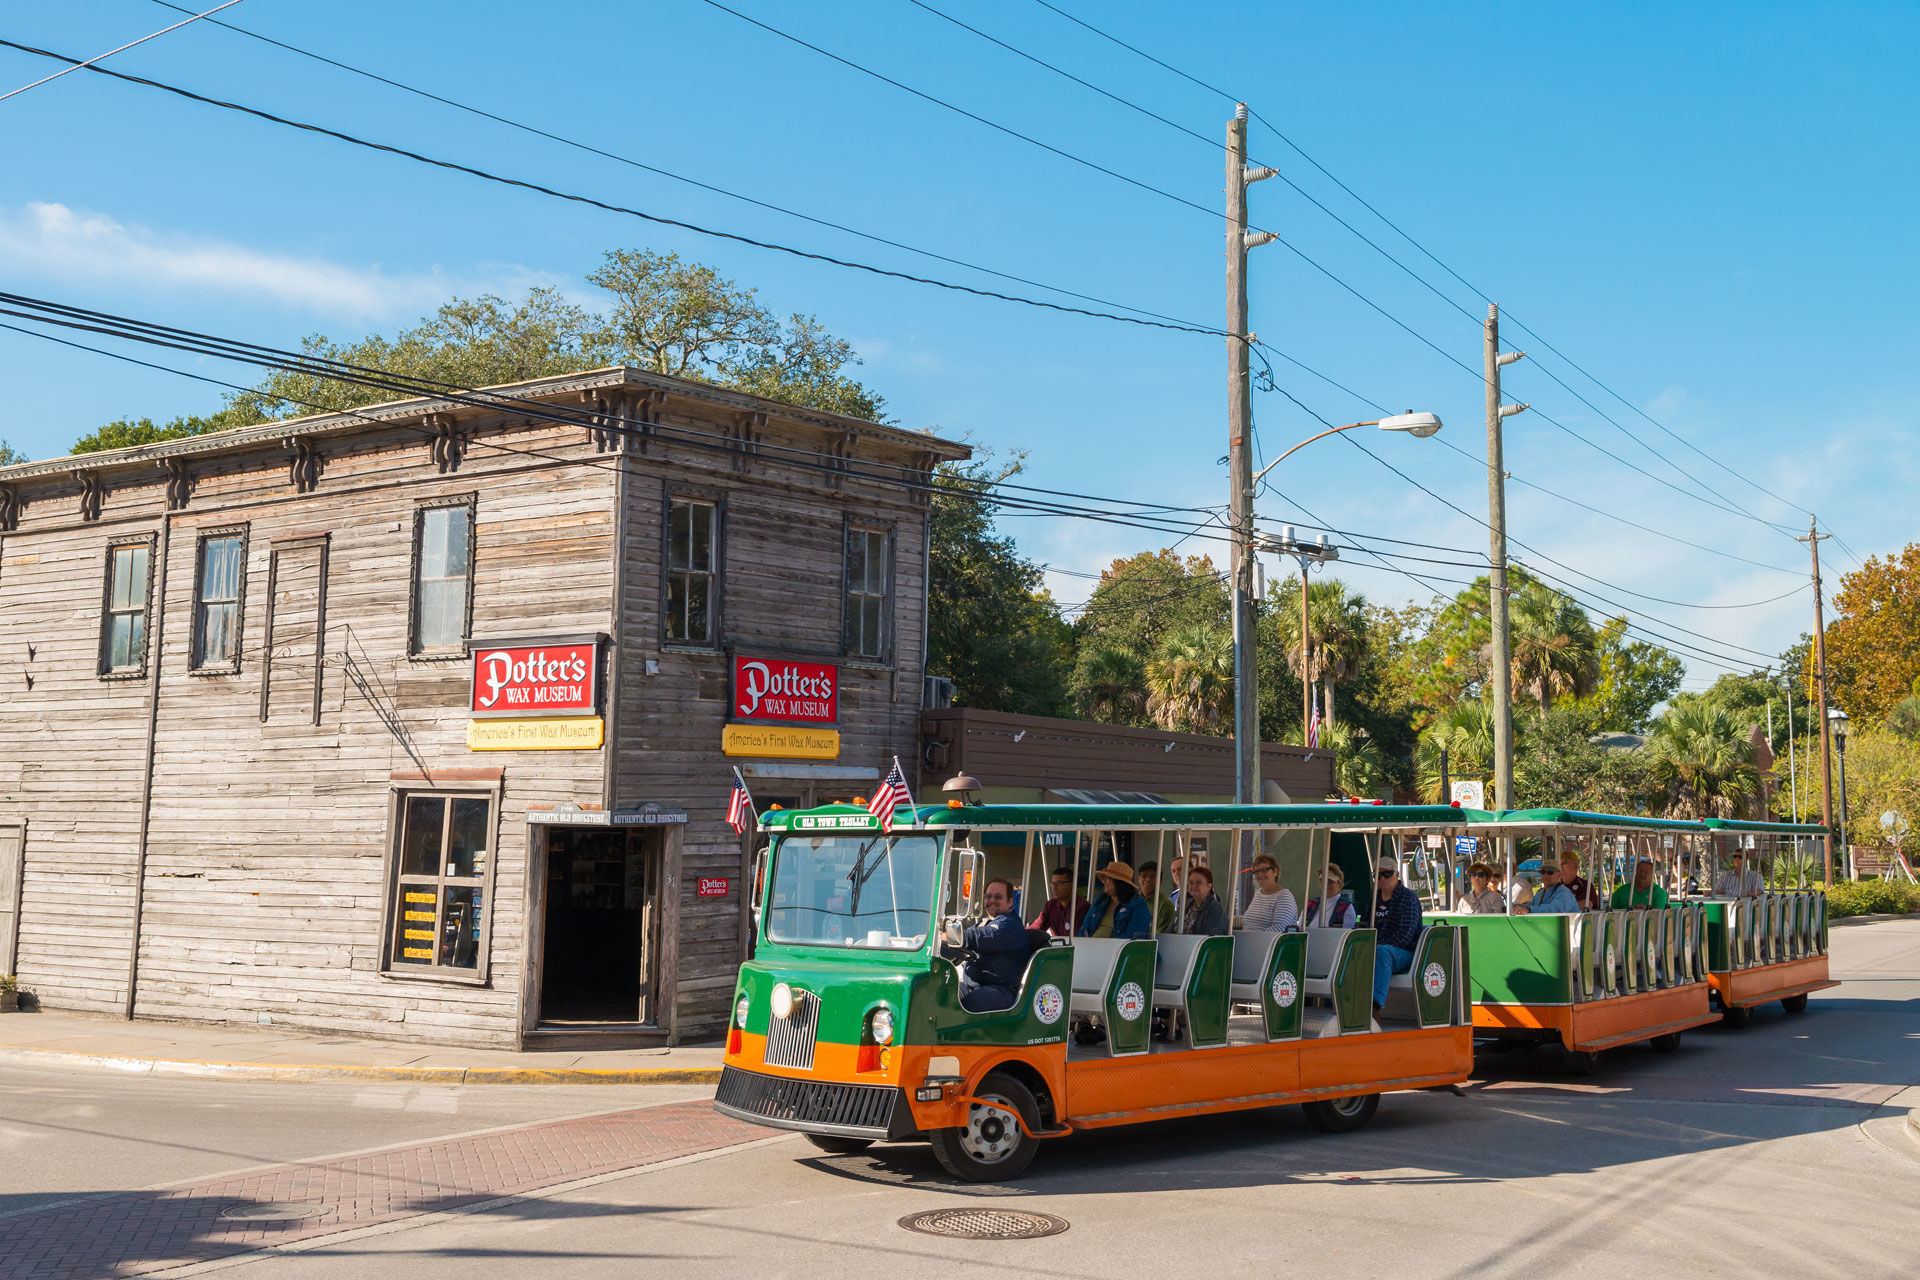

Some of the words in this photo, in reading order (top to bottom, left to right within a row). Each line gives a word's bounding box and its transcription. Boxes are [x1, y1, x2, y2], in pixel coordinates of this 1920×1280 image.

[479, 651, 586, 708] Potter's
[506, 687, 530, 703] WAX
[534, 685, 582, 703] MUSEUM
[739, 661, 833, 715] Potter's
[765, 699, 786, 715] WAX
[790, 700, 829, 717] MUSEUM
[473, 726, 515, 741] America's
[518, 725, 537, 739] First
[540, 724, 557, 738] Wax
[560, 724, 596, 738] Museum
[729, 732, 767, 747] America's
[769, 734, 787, 747] First
[788, 735, 804, 747] Wax
[805, 736, 834, 749] Museum
[560, 813, 571, 822] OLD
[614, 814, 644, 824] AUTHENTIC
[645, 814, 656, 823] OLD
[657, 813, 688, 823] DRUGSTORE
[802, 817, 815, 827] OLD
[817, 817, 837, 827] TOWN
[839, 816, 870, 827] TROLLEY
[1045, 833, 1063, 846] ATM
[700, 879, 727, 894] Potter's
[945, 975, 950, 984] 7
